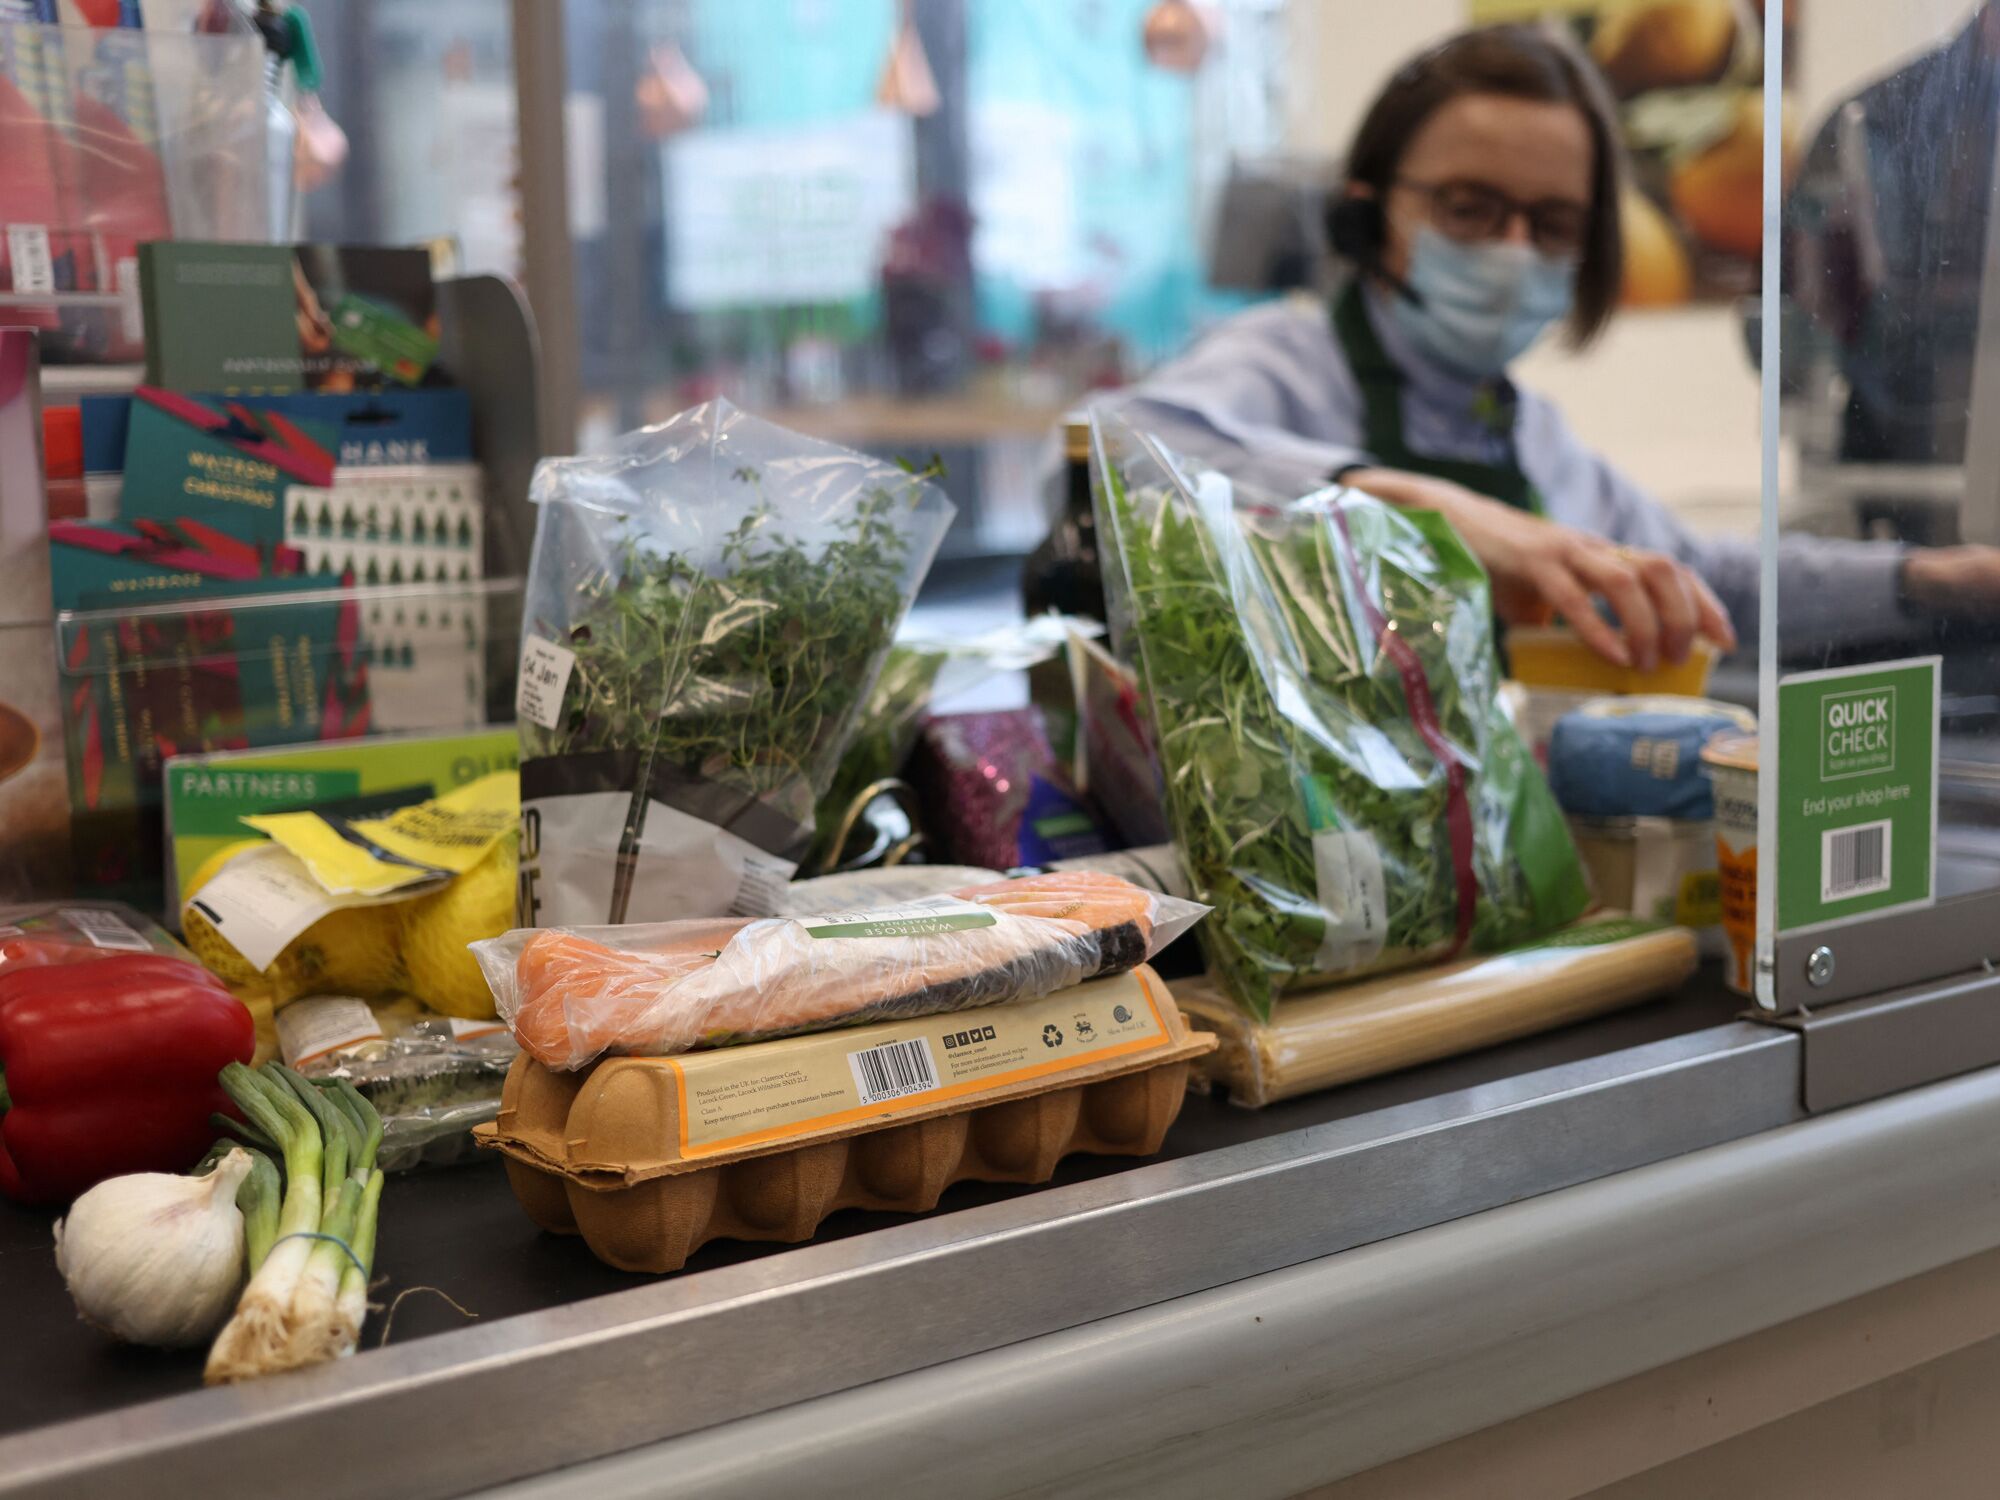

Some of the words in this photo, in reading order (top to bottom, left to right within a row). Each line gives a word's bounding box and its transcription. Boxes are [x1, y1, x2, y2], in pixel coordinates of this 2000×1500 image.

[340, 440, 428, 464] HANK
[1828, 697, 1888, 728] QUICK
[1828, 724, 1888, 756] CHECK
[182, 772, 317, 799] PARTNERS
[1803, 796, 1826, 816] End
[1827, 793, 1853, 816] your
[1855, 789, 1884, 809] shop
[1884, 783, 1911, 801] here
[864, 923, 954, 936] WAITROSE
[953, 1069, 968, 1078] please
[960, 1059, 973, 1067] more
[696, 1087, 723, 1097] Produced
[761, 1074, 784, 1083] Clarence
[699, 1095, 718, 1105] Lacock
[738, 1088, 757, 1096] Lacock
[757, 1082, 781, 1091] Wiltshire
[872, 1089, 901, 1101] 000306
[903, 1082, 932, 1094] 004394
[704, 1118, 719, 1126] Keep
[720, 1109, 751, 1121] refrigerated
[753, 1106, 765, 1114] after
[766, 1101, 789, 1112] purchase
[797, 1094, 820, 1104] maintain
[820, 1089, 845, 1099] freshness
